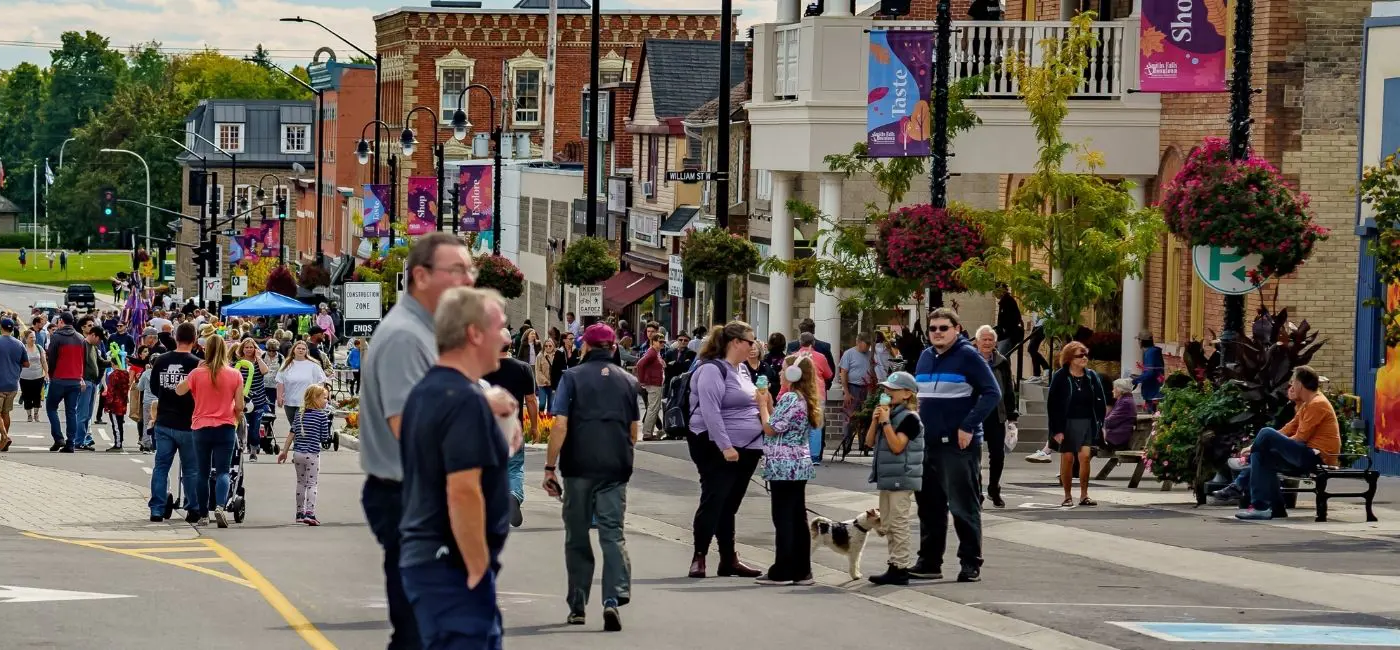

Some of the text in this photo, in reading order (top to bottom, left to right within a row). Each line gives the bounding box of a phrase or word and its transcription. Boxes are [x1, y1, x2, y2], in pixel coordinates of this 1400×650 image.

[1170, 0, 1192, 42] Sho
[892, 69, 908, 118] Taste
[670, 172, 696, 180] WILLIAM
[706, 172, 712, 180] W
[417, 195, 428, 218] Shop
[471, 179, 483, 216] Explore
[355, 302, 370, 310] ZONE
[353, 324, 373, 332] ENDS
